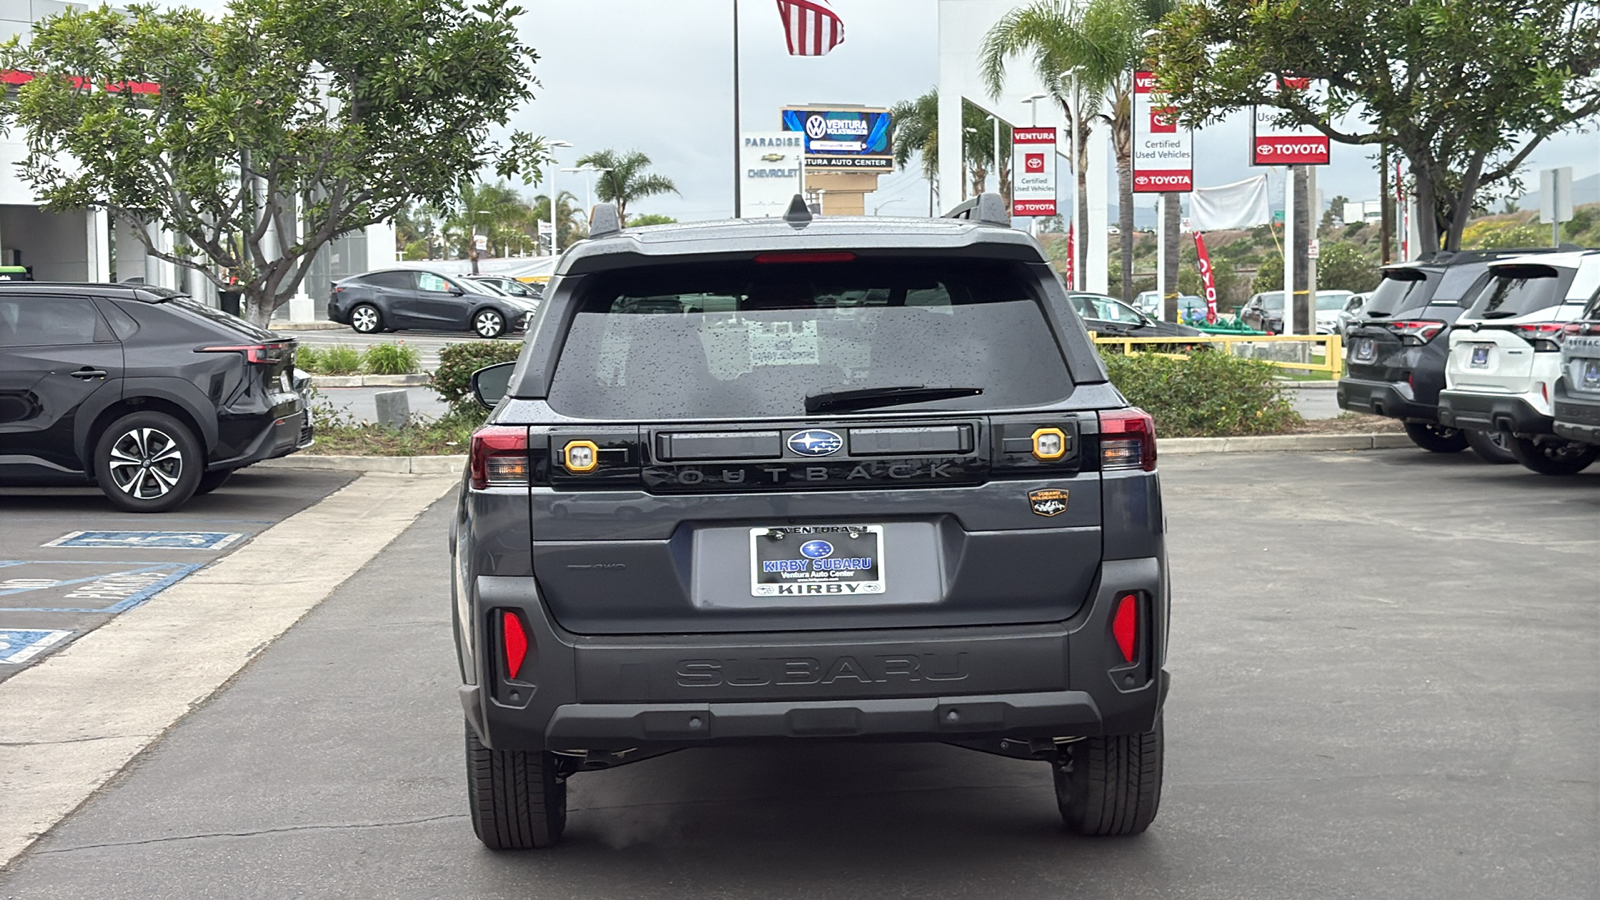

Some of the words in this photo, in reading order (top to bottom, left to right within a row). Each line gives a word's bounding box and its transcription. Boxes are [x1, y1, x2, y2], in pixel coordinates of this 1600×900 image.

[826, 119, 868, 129] VENTURA
[1014, 132, 1055, 140] VENTURA
[745, 137, 800, 146] PARADISE
[1145, 140, 1181, 148] Certified
[1274, 143, 1327, 154] TOYOTA
[1135, 151, 1156, 159] Used
[1158, 151, 1190, 159] Vehicles
[747, 168, 800, 178] CHEVROLET
[1149, 175, 1191, 184] TOYOTA
[679, 462, 952, 485] OUTBACK
[784, 526, 850, 534] VENTURA
[763, 559, 809, 572] KIRBY
[813, 557, 872, 571] SUBARU
[781, 571, 810, 579] Ventura
[810, 570, 829, 578] Auto
[829, 569, 855, 577] Center
[778, 583, 860, 594] KIRBY
[676, 653, 968, 687] SUBARU
